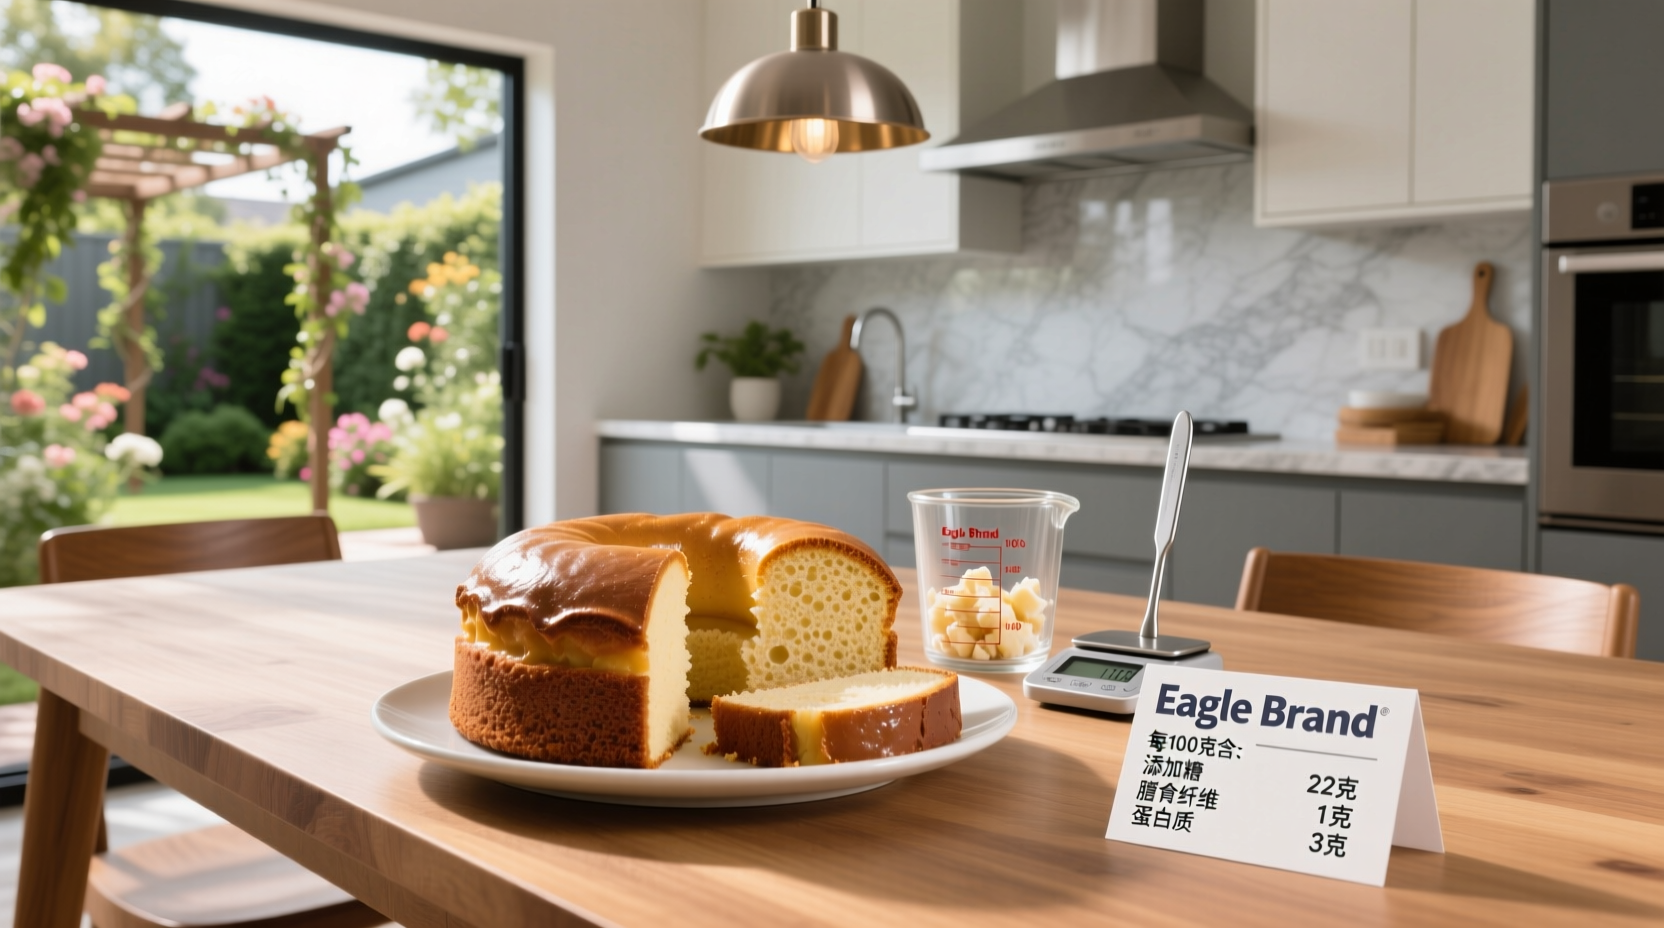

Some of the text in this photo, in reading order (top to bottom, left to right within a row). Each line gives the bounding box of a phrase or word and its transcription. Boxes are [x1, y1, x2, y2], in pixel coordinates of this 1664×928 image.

[1155, 683, 1379, 739] Eagle Brand
[1306, 773, 1360, 801] 22克
[1131, 804, 1348, 858] 蛋白质 3克
[1317, 804, 1354, 830] 1克
